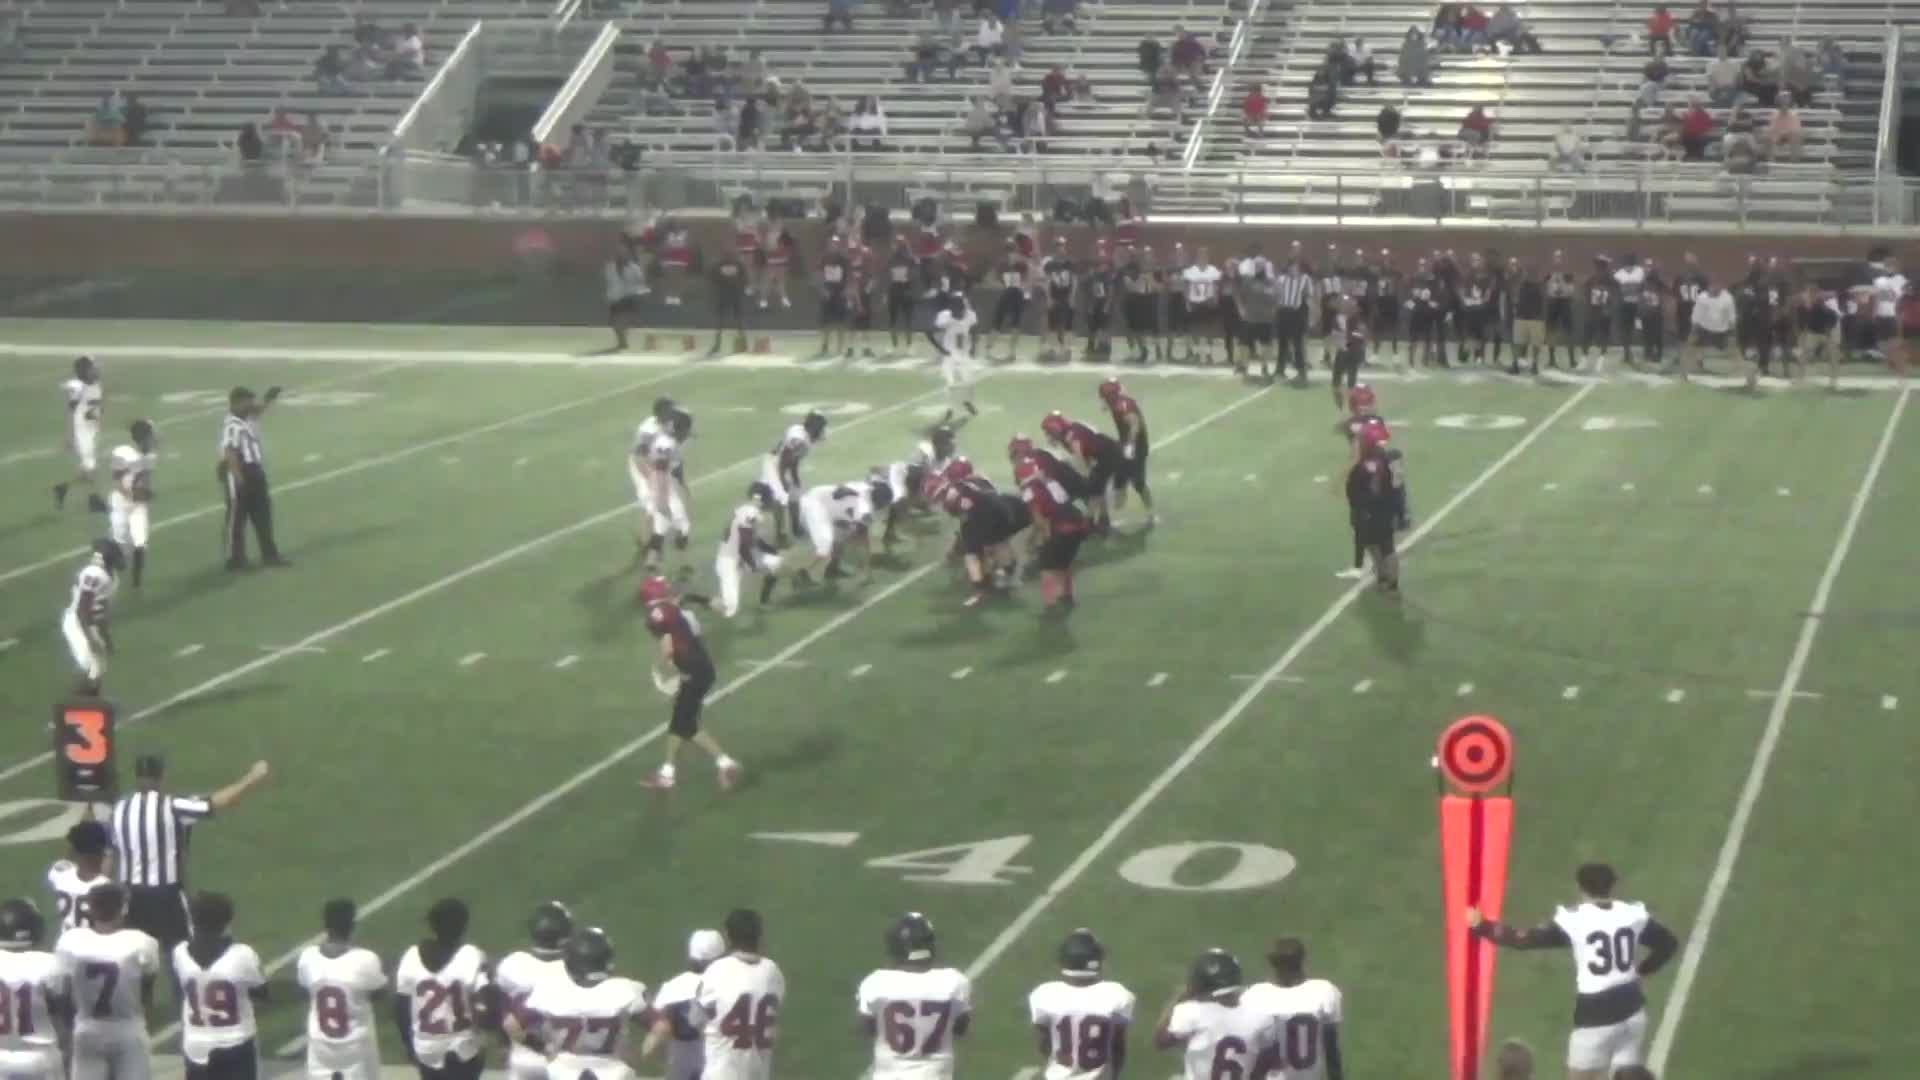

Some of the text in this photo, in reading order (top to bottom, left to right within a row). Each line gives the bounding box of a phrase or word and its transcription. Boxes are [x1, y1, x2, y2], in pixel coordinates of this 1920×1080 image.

[64, 708, 108, 765] 3
[1586, 927, 1636, 977] 30
[85, 962, 120, 1018] 7
[184, 978, 242, 1028] 19
[316, 985, 351, 1039] 8
[416, 979, 472, 1034] 21
[883, 1000, 952, 1055] 67
[1055, 1014, 1112, 1070] 18
